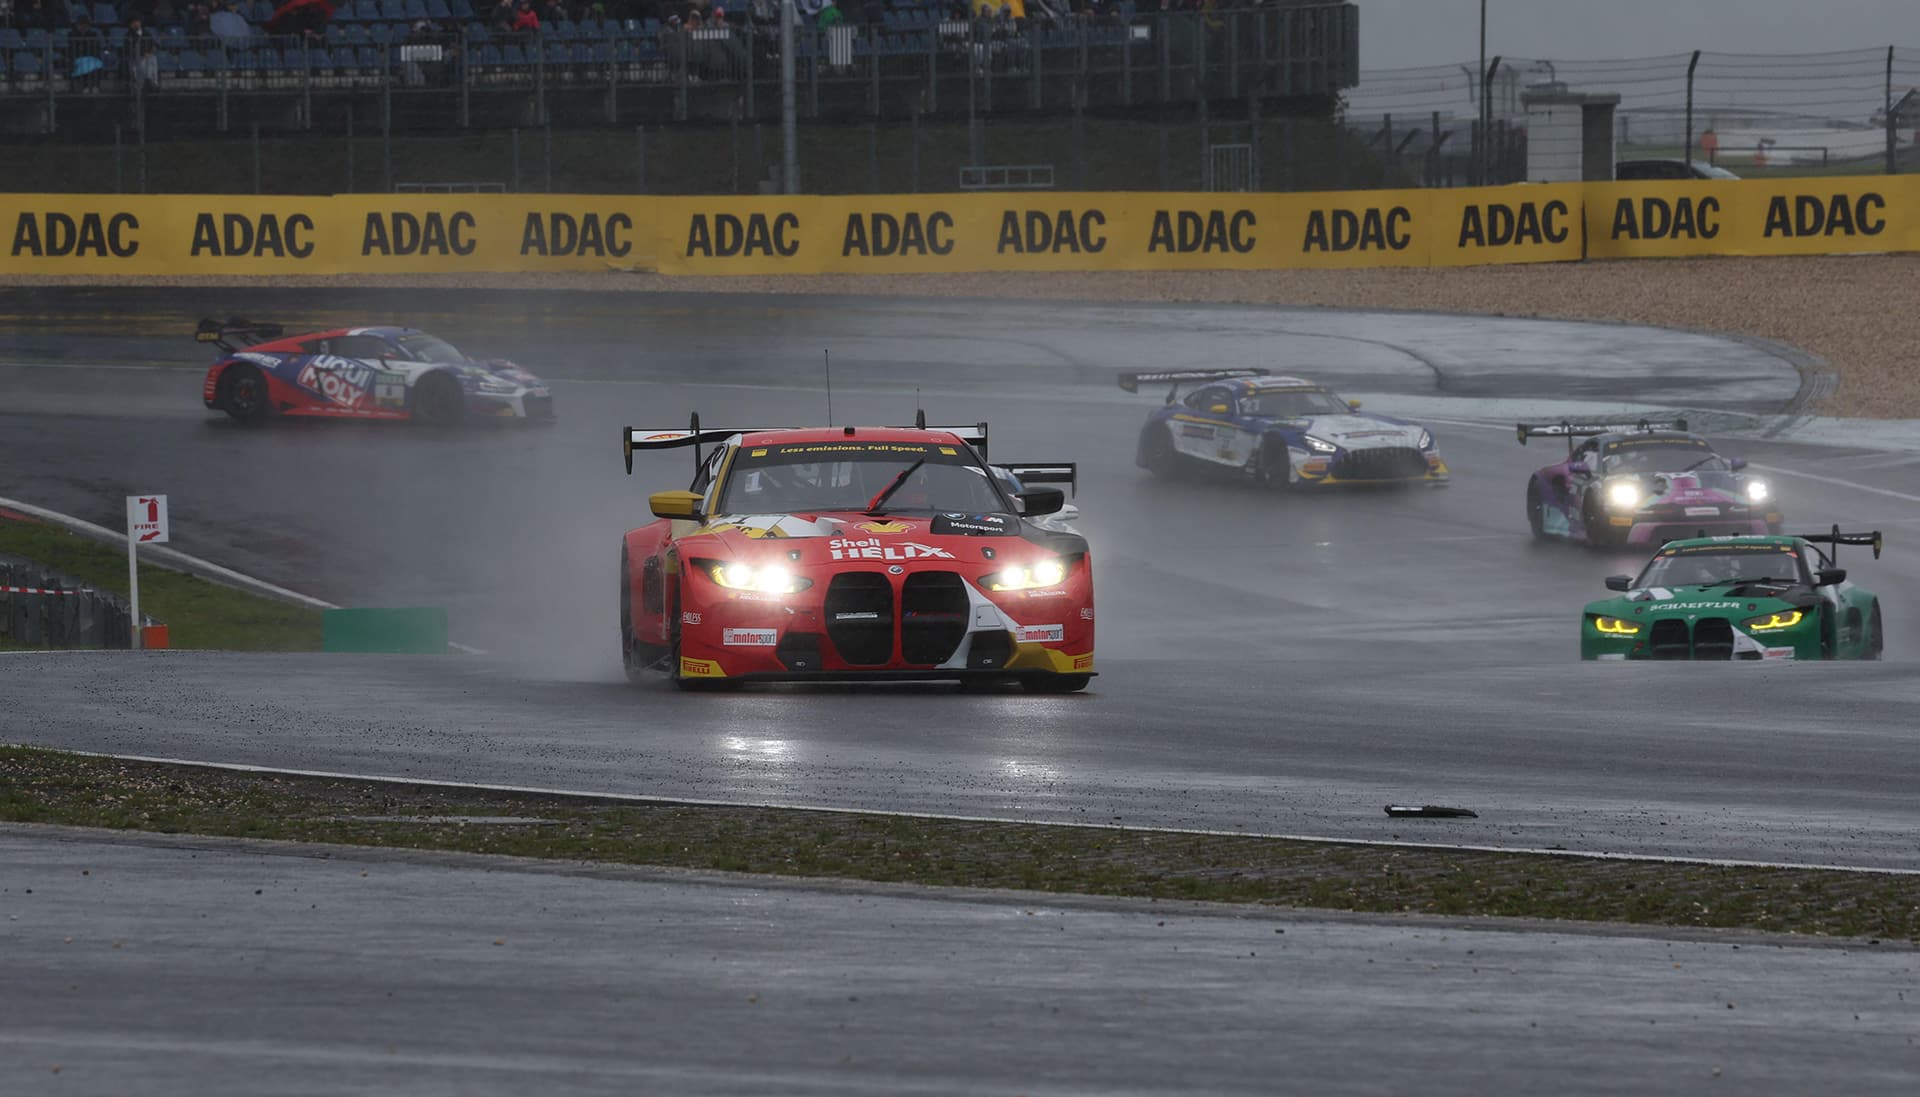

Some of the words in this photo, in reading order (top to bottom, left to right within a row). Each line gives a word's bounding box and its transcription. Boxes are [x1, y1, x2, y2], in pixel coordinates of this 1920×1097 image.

[12, 213, 138, 257] ADAC
[192, 214, 313, 257] ADAC
[363, 213, 475, 255] ADAC
[522, 214, 631, 256] ADAC
[687, 214, 798, 256] ADAC
[843, 212, 953, 255] ADAC
[999, 211, 1105, 253] ADAC
[1149, 209, 1255, 253] ADAC
[1304, 207, 1410, 252] ADAC
[1459, 203, 1568, 247] ADAC
[1611, 198, 1719, 241] ADAC
[1764, 194, 1884, 237] ADAC
[302, 367, 363, 406] MOLY
[780, 446, 804, 454] Less
[806, 445, 865, 453] emissions.
[890, 445, 928, 454] Speed.
[829, 537, 881, 549] Shell
[950, 521, 1005, 533] Motorsport
[830, 541, 955, 561] HELIX
[1649, 601, 1740, 612] SCHAEFFLER
[733, 631, 777, 645] motorsport
